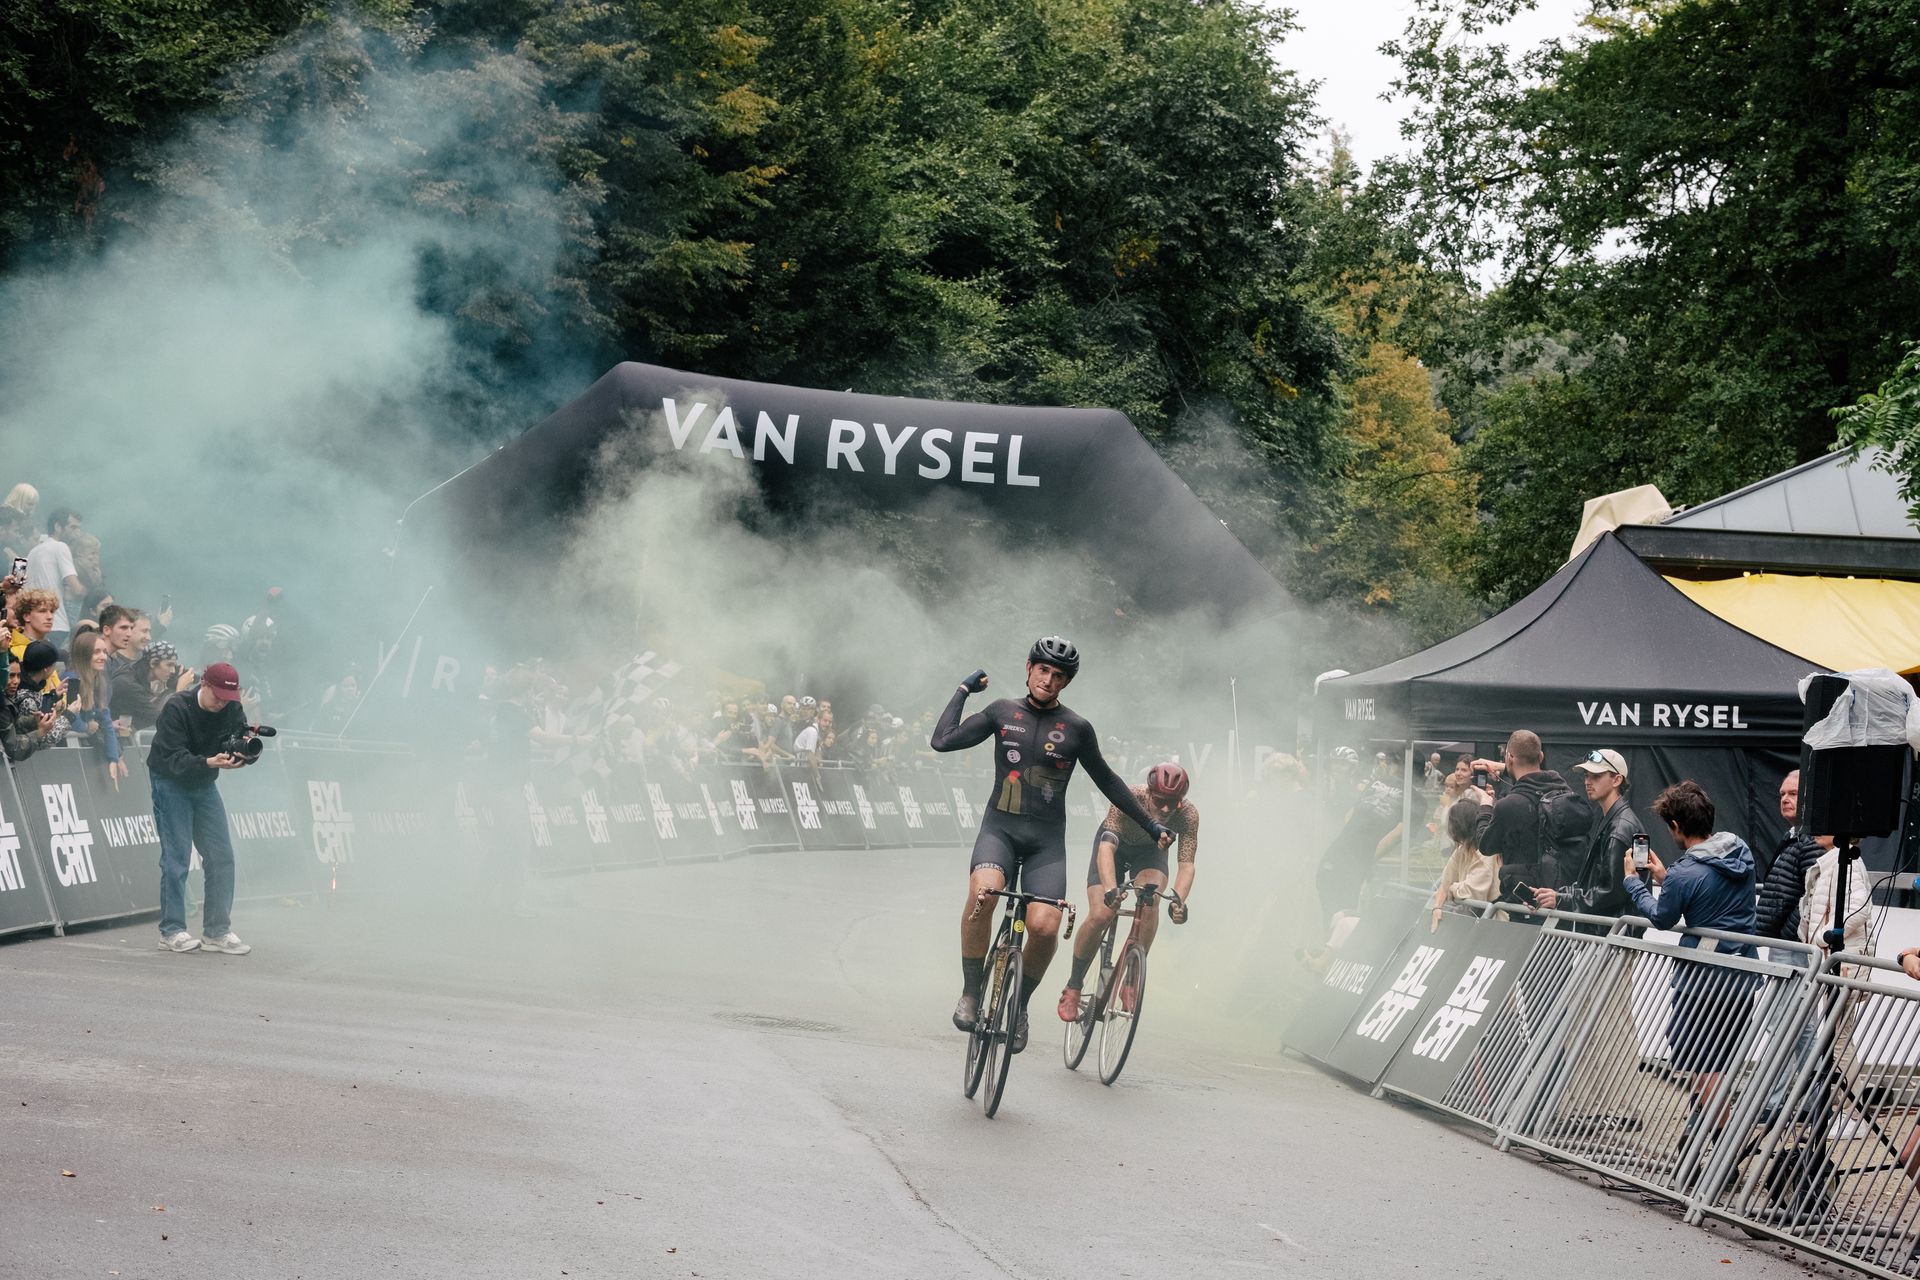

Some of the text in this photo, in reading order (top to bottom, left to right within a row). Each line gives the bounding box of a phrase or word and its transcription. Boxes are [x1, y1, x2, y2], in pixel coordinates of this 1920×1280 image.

[662, 397, 1041, 487] VAN RYSEL
[1344, 697, 1376, 720] VAN RYSEL
[1577, 701, 1748, 729] VAN RYSEL
[307, 780, 352, 822] BXL
[646, 783, 671, 811] BXL
[730, 779, 754, 805] BXL
[757, 797, 788, 814] VAN RYSEL
[791, 781, 817, 806] BXL
[41, 783, 90, 835] BXL
[822, 800, 856, 816] VAN RYSEL
[100, 817, 130, 848] VAN
[230, 810, 296, 839] VAN RYSEL
[1390, 944, 1446, 998] BXL
[1445, 955, 1506, 1013] BXL
